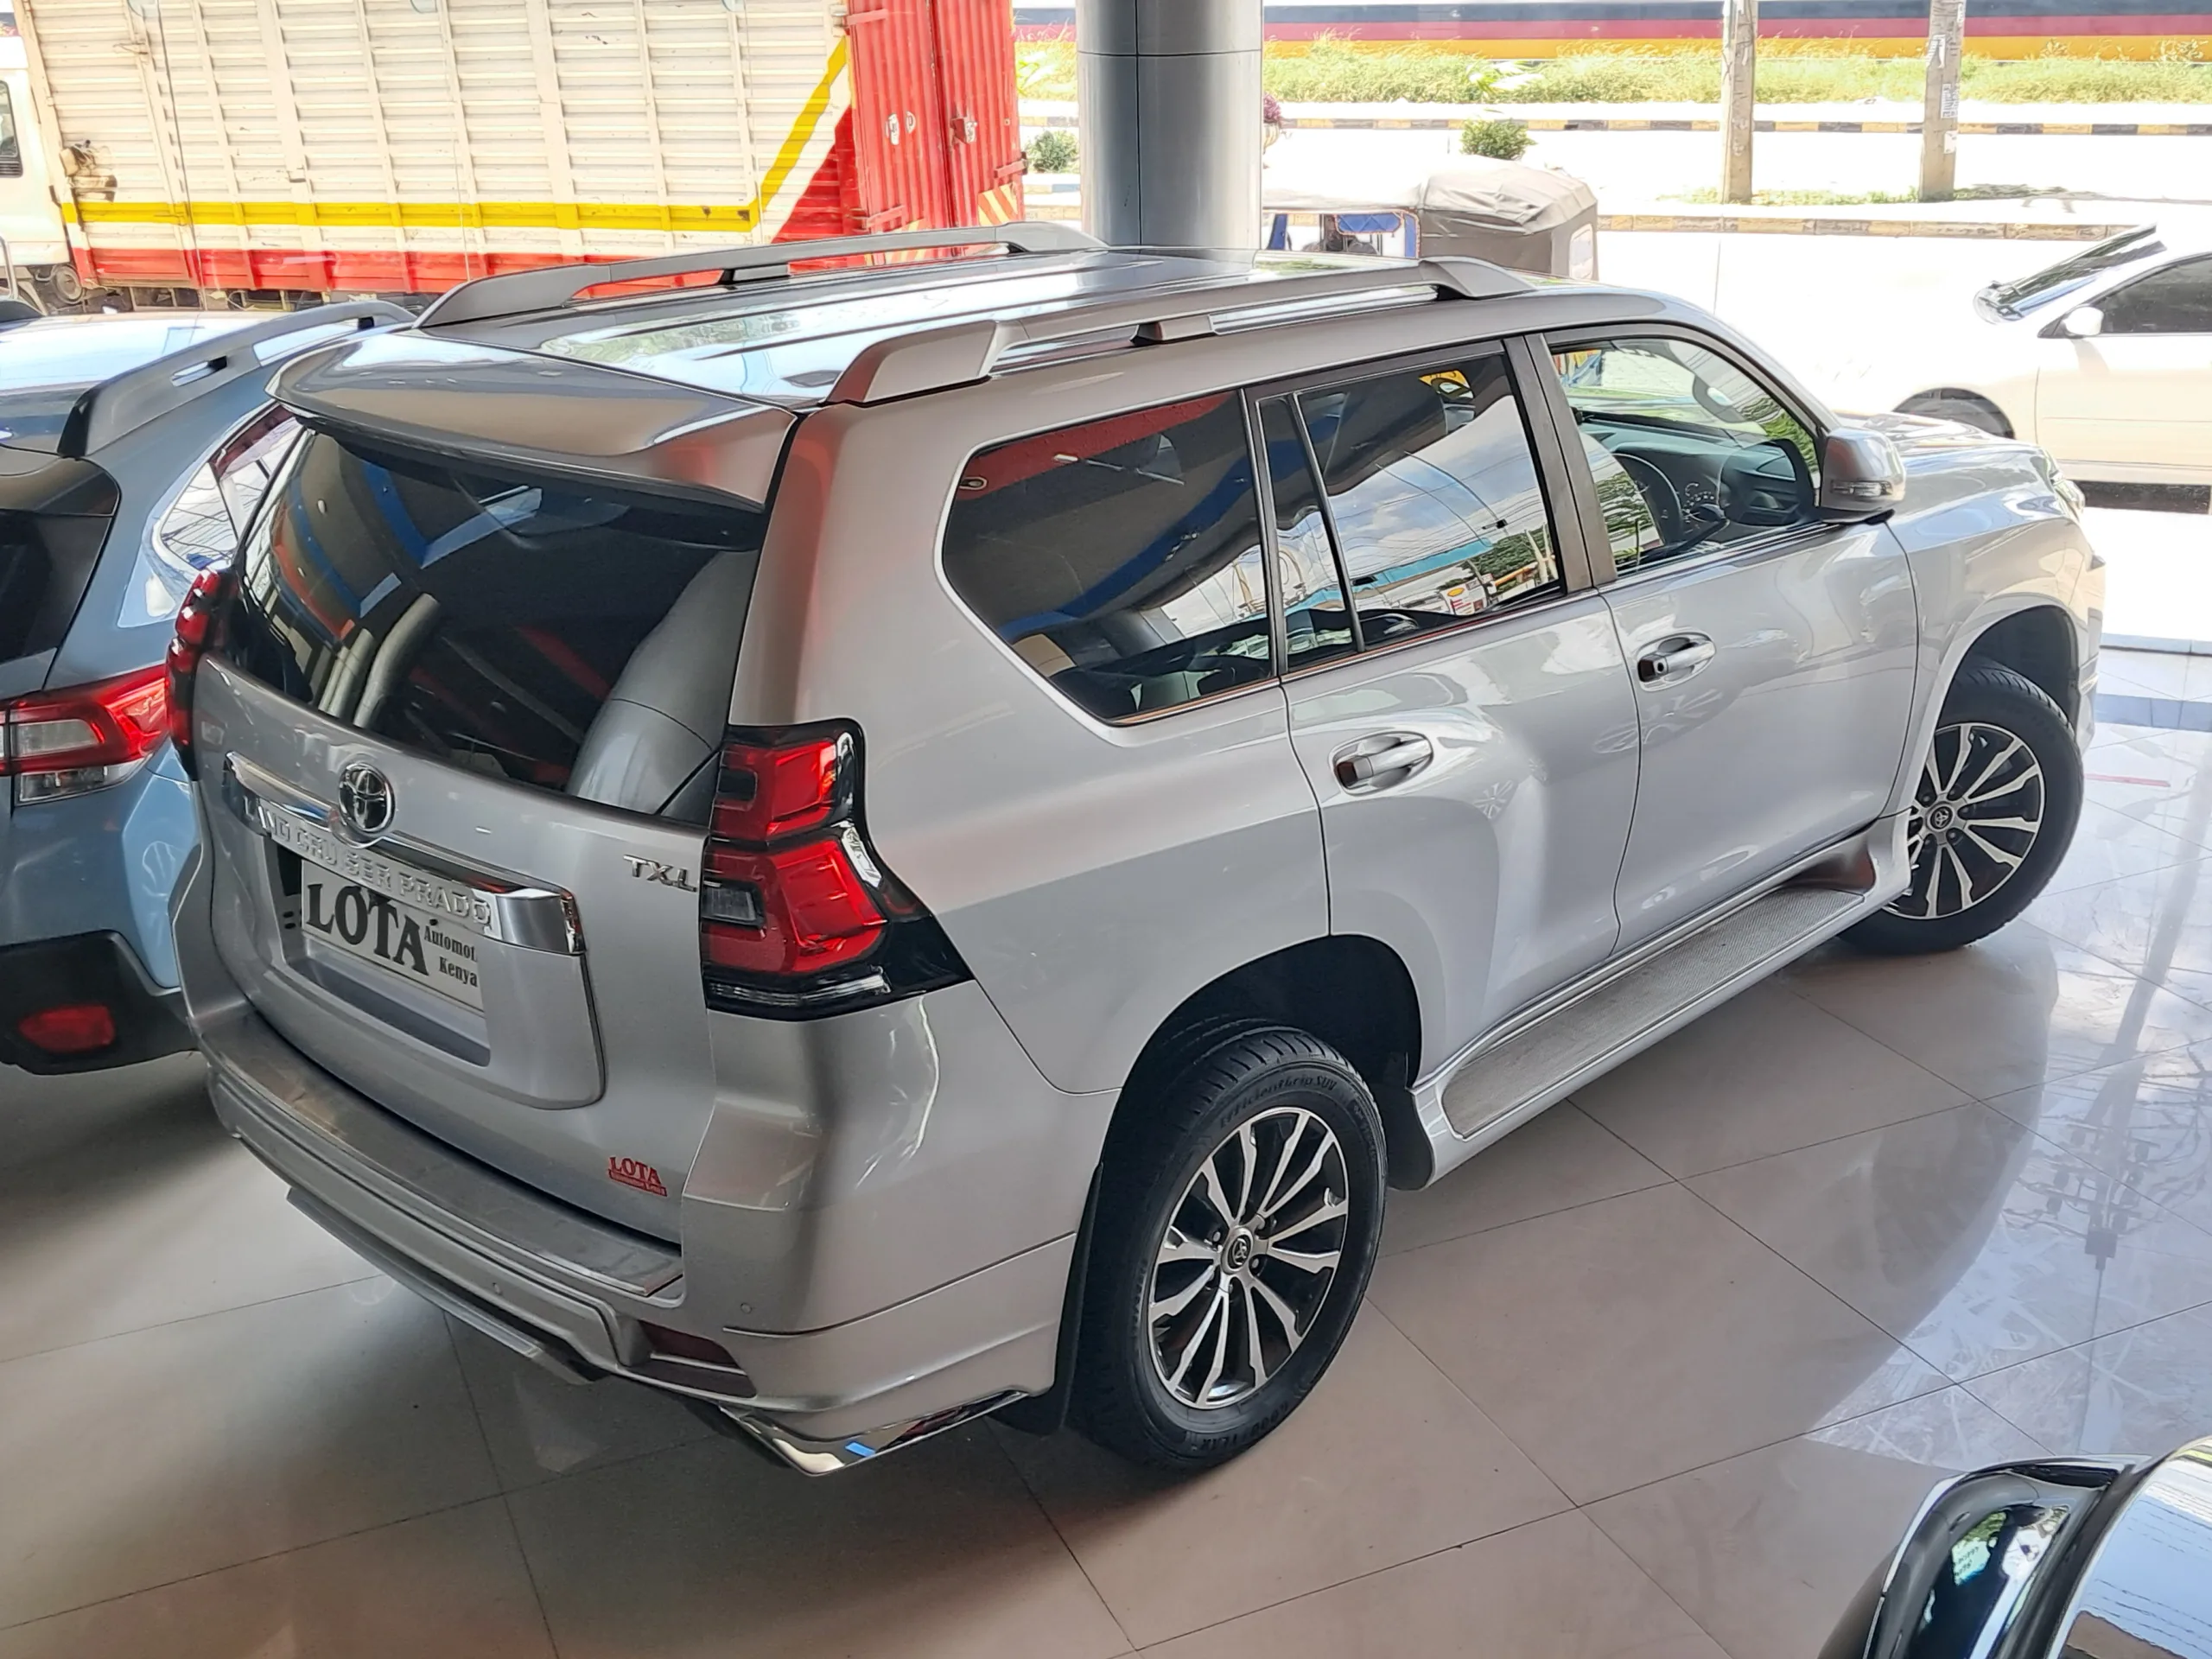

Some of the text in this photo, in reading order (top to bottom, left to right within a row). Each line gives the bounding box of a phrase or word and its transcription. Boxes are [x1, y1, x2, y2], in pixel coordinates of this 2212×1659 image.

[623, 855, 697, 893] TXL
[398, 870, 492, 926] PRADO
[307, 884, 429, 976] LOTA
[440, 956, 478, 988] Kenya
[609, 1157, 662, 1185] LOTA
